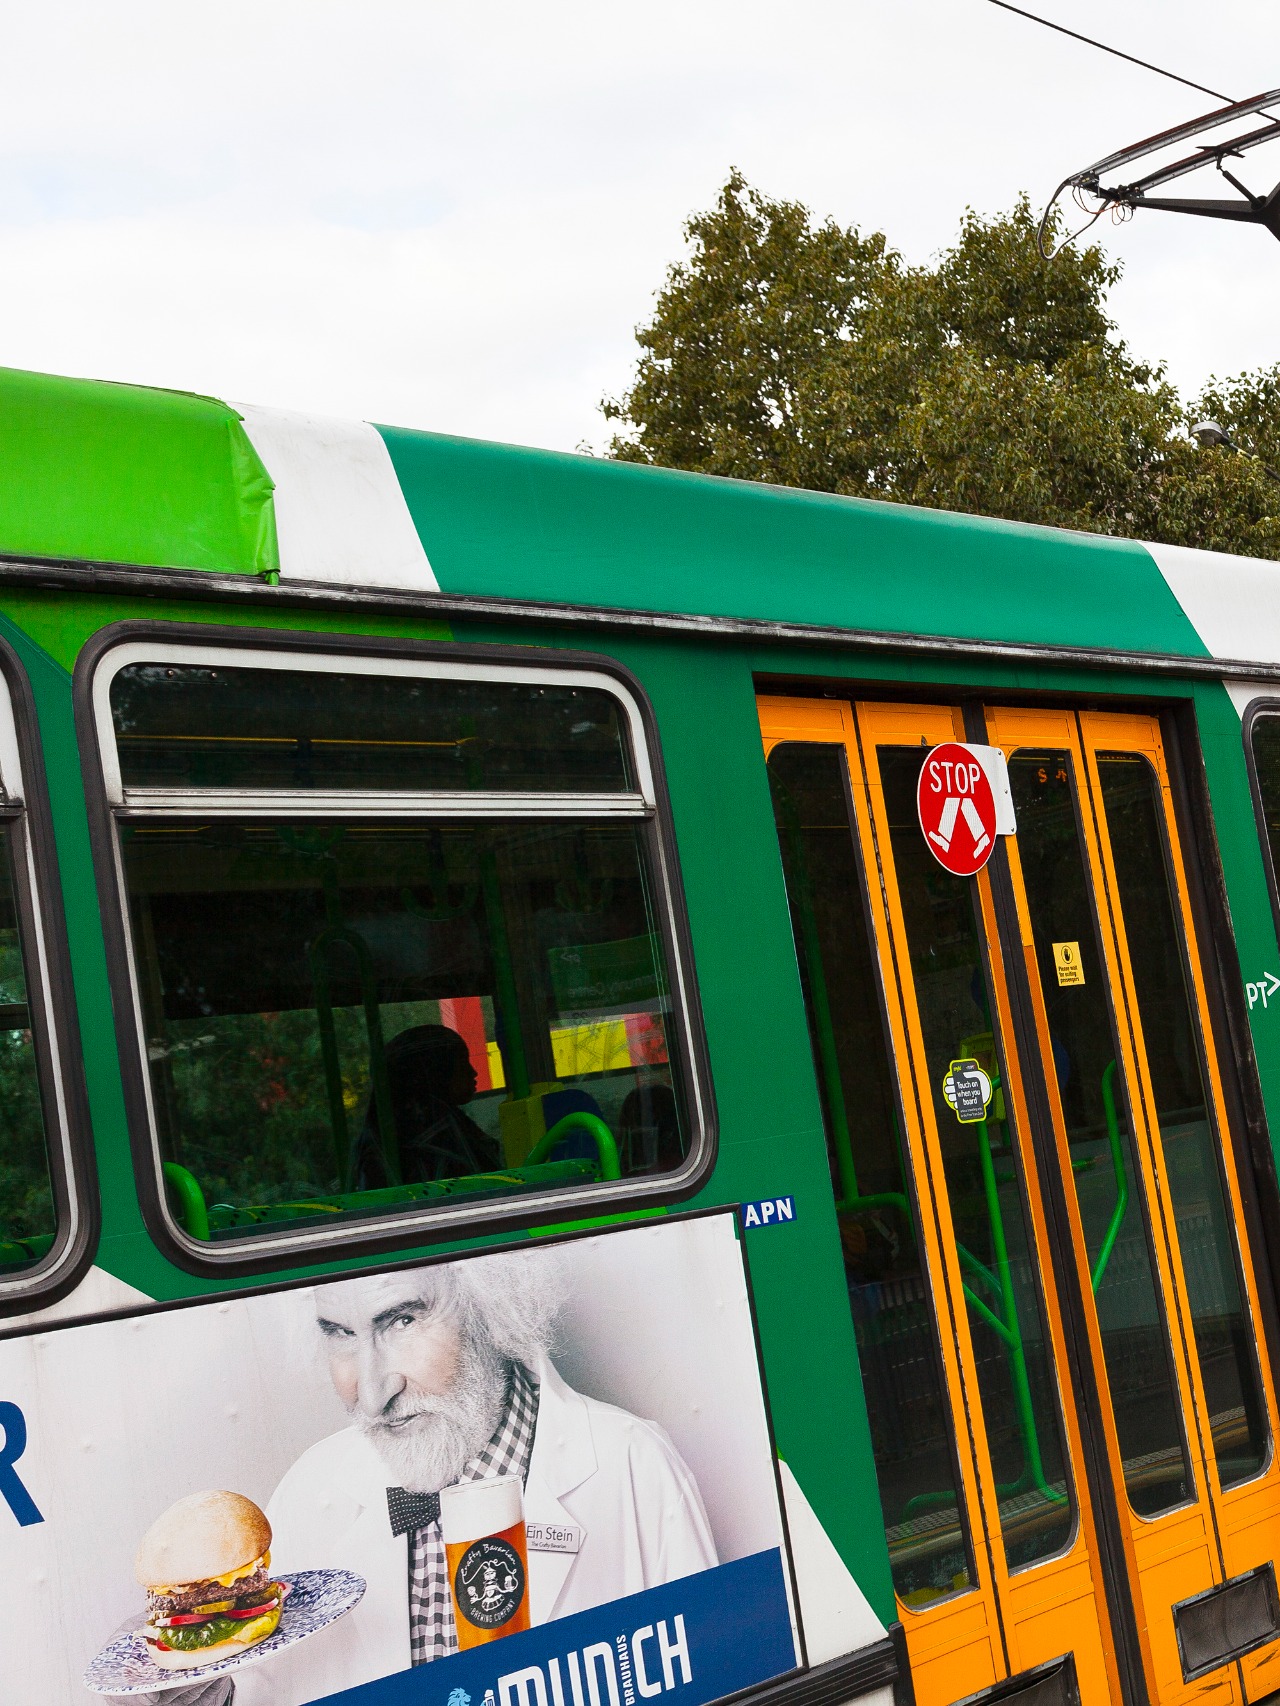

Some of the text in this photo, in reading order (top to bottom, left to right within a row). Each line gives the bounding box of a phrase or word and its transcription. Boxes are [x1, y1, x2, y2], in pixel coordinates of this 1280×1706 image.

[929, 761, 981, 794] STOP
[957, 1081, 971, 1089] Touch
[957, 1090, 981, 1098] when you
[962, 1098, 978, 1106] board
[745, 1198, 793, 1227] APN
[526, 1525, 573, 1542] Ein Stein
[483, 1543, 517, 1566] Bavarian
[470, 1598, 516, 1623] BREWING COMPANY
[616, 1634, 635, 1706] BRAUHAUS
